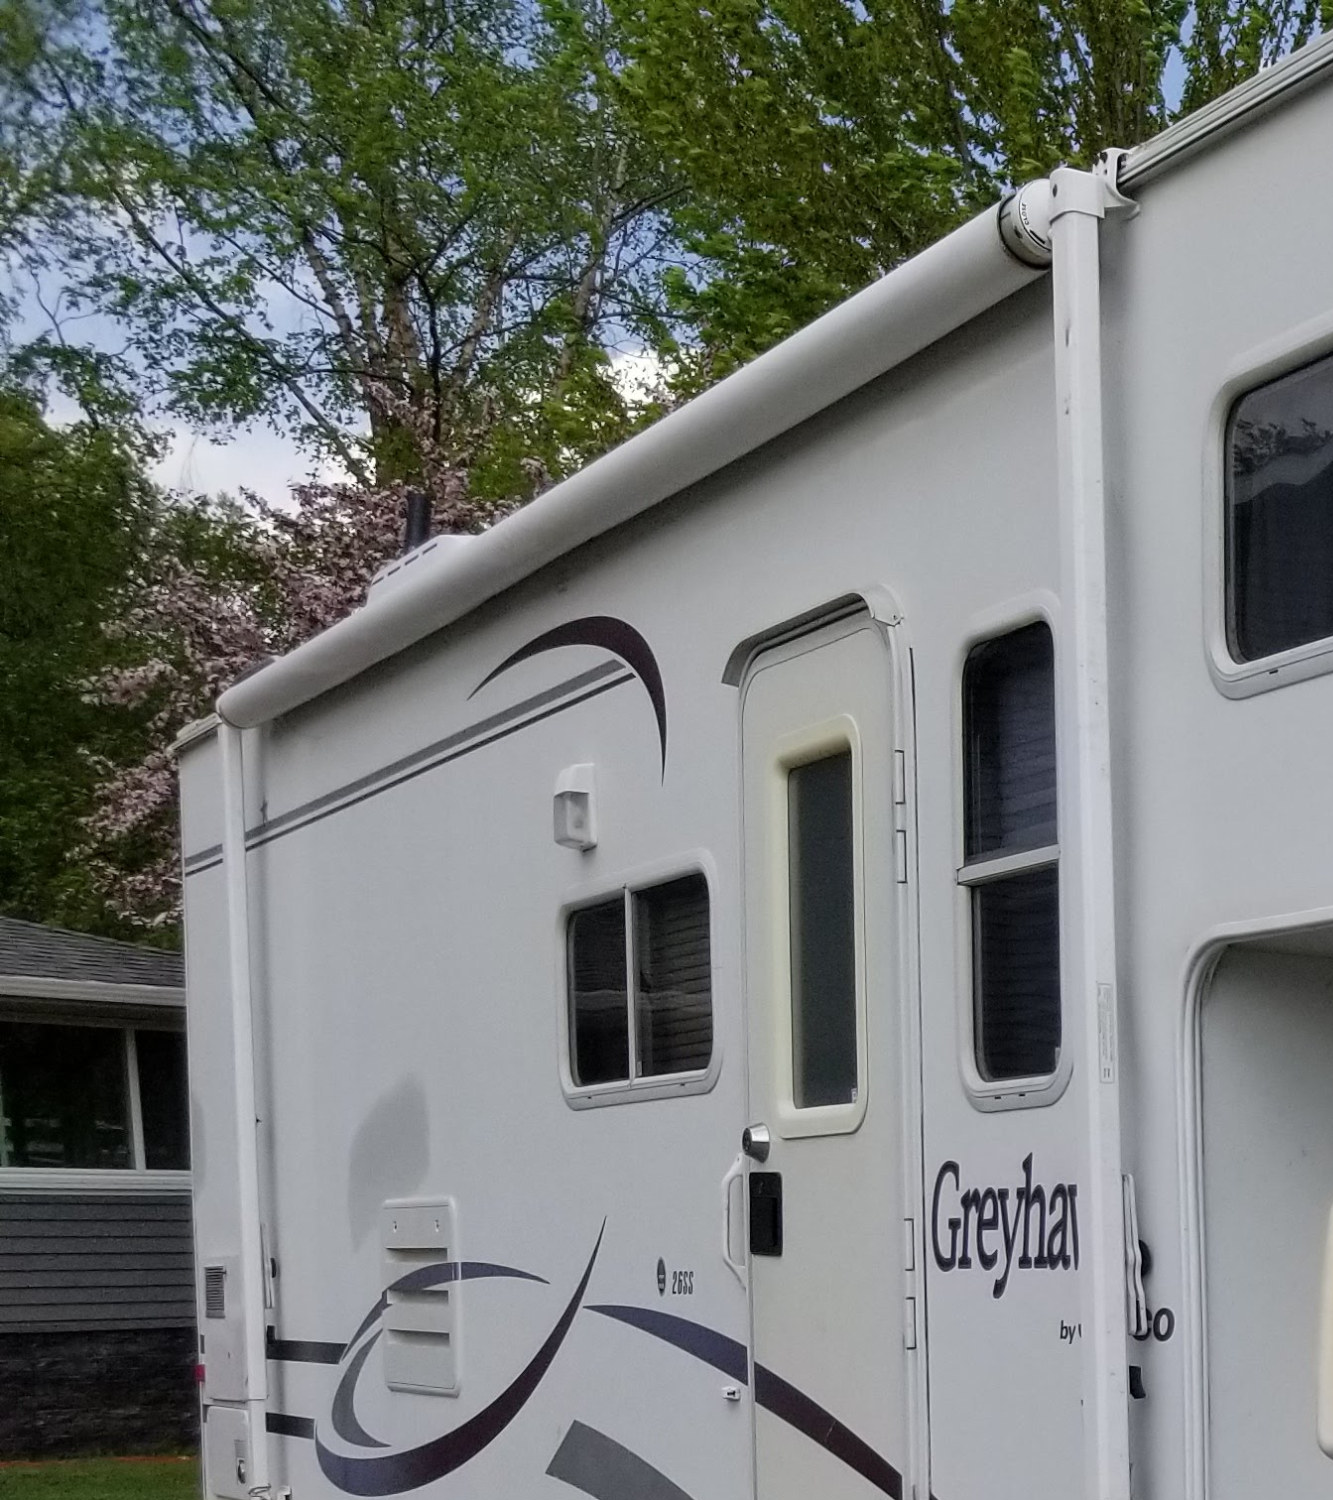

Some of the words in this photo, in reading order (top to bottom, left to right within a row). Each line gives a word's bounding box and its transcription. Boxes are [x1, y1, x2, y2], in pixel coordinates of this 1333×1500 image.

[931, 1152, 1080, 1300] Greyha
[671, 1270, 694, 1296] 26SS
[1059, 1320, 1077, 1344] by
